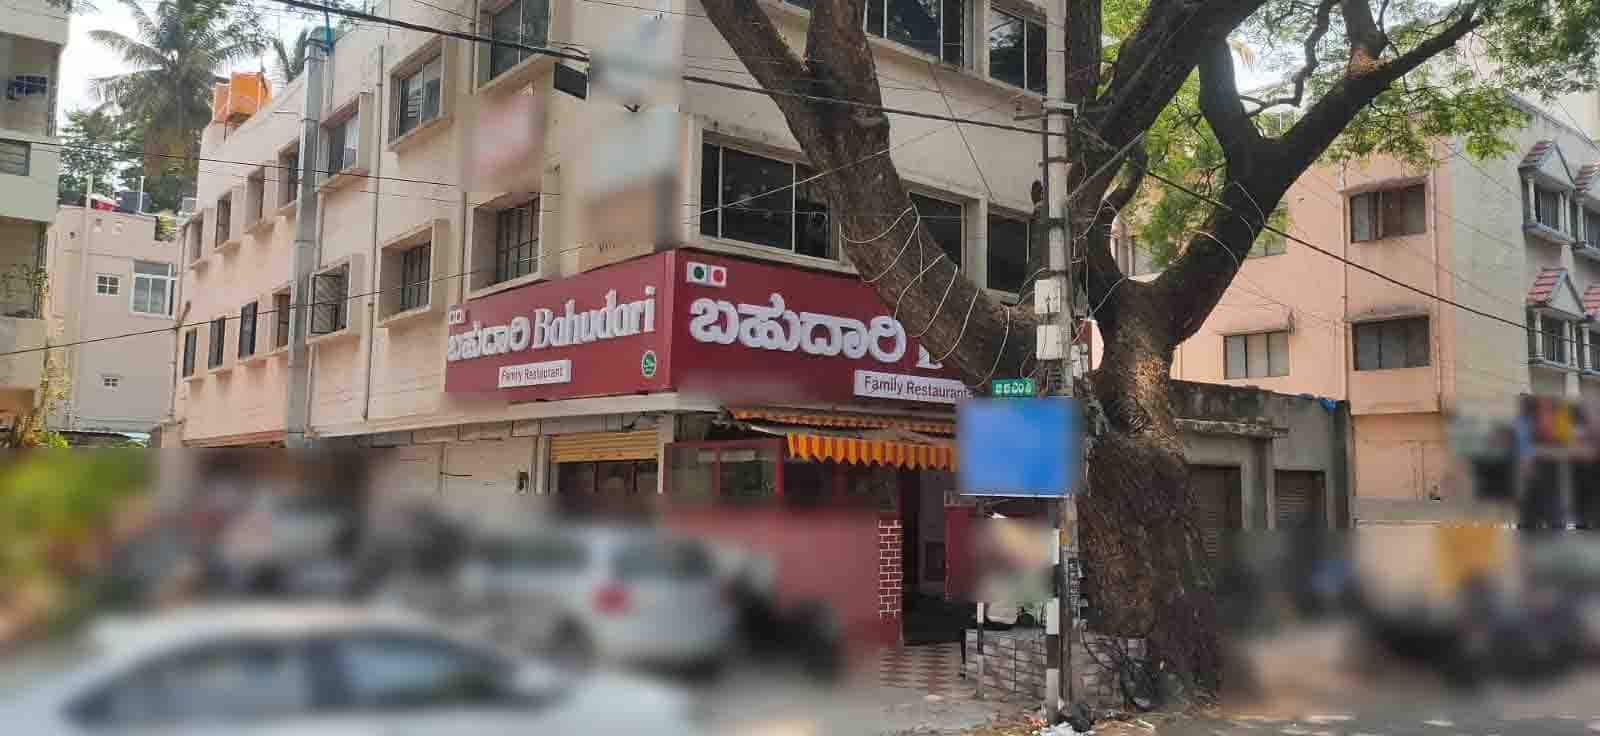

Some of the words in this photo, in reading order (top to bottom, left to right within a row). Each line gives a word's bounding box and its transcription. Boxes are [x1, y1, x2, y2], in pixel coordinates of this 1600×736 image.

[532, 286, 656, 349] Bahudari
[689, 293, 907, 363] ಬಹುದಾರಿ
[524, 366, 563, 380] Restaurant
[864, 376, 903, 395] Family
